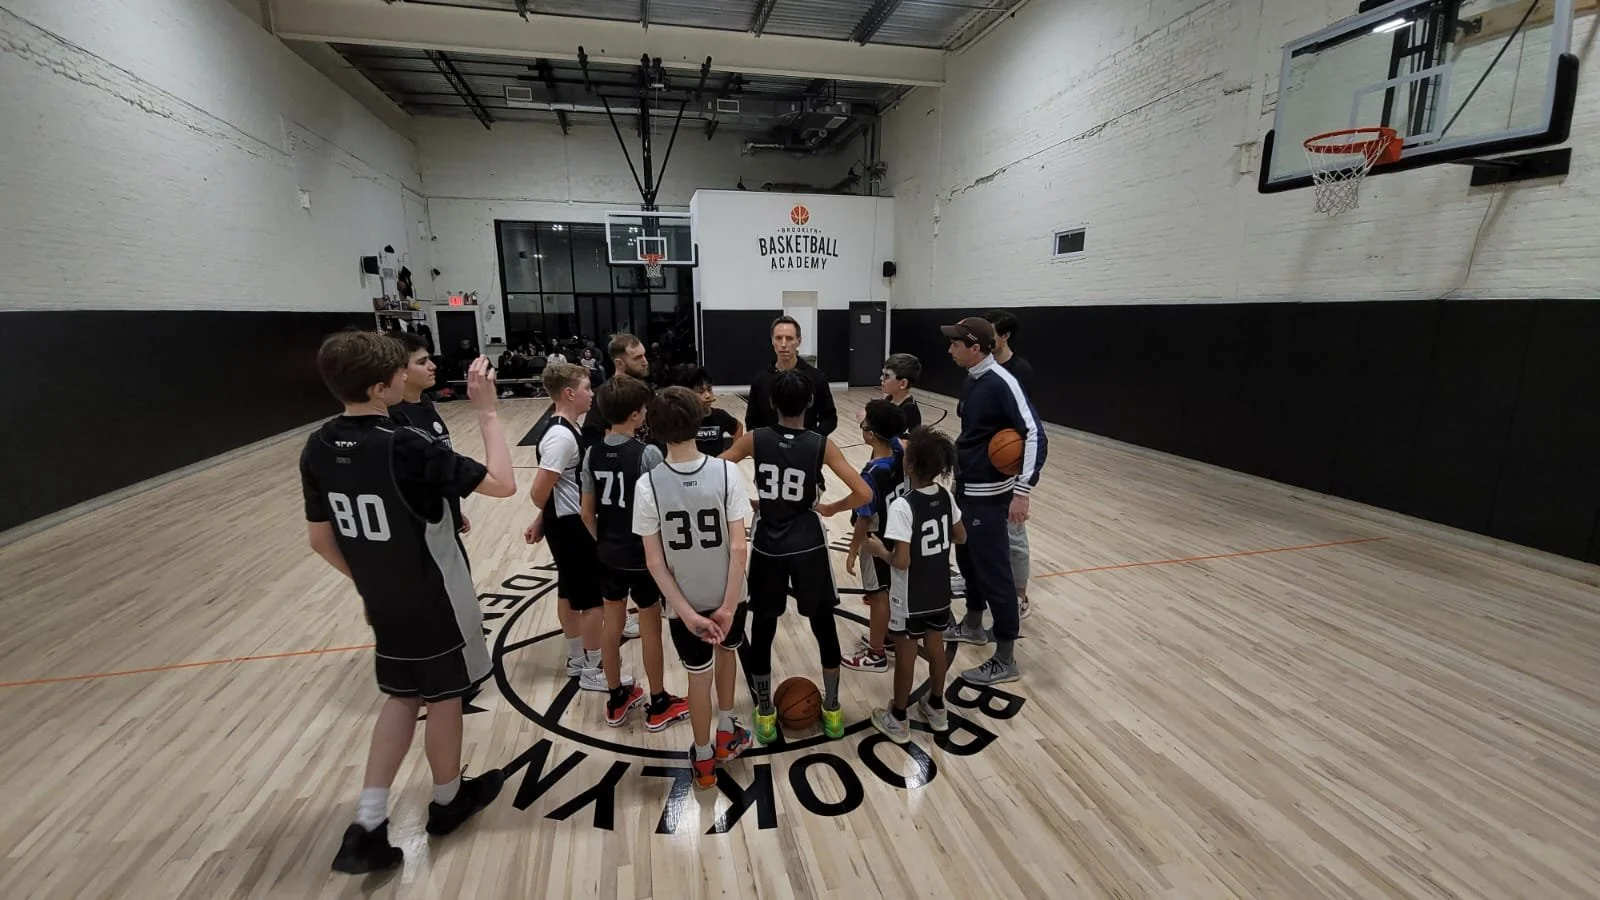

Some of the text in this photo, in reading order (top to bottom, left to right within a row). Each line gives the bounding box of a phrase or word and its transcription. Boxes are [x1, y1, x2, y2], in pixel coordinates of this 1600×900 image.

[759, 235, 838, 257] BASKETBALL
[771, 256, 827, 270] ACADEMY
[593, 471, 626, 508] 71
[758, 463, 806, 501] 38
[328, 492, 391, 541] 80
[665, 508, 723, 550] 39
[921, 514, 950, 556] 21
[500, 677, 1027, 835] BROOKLYN
